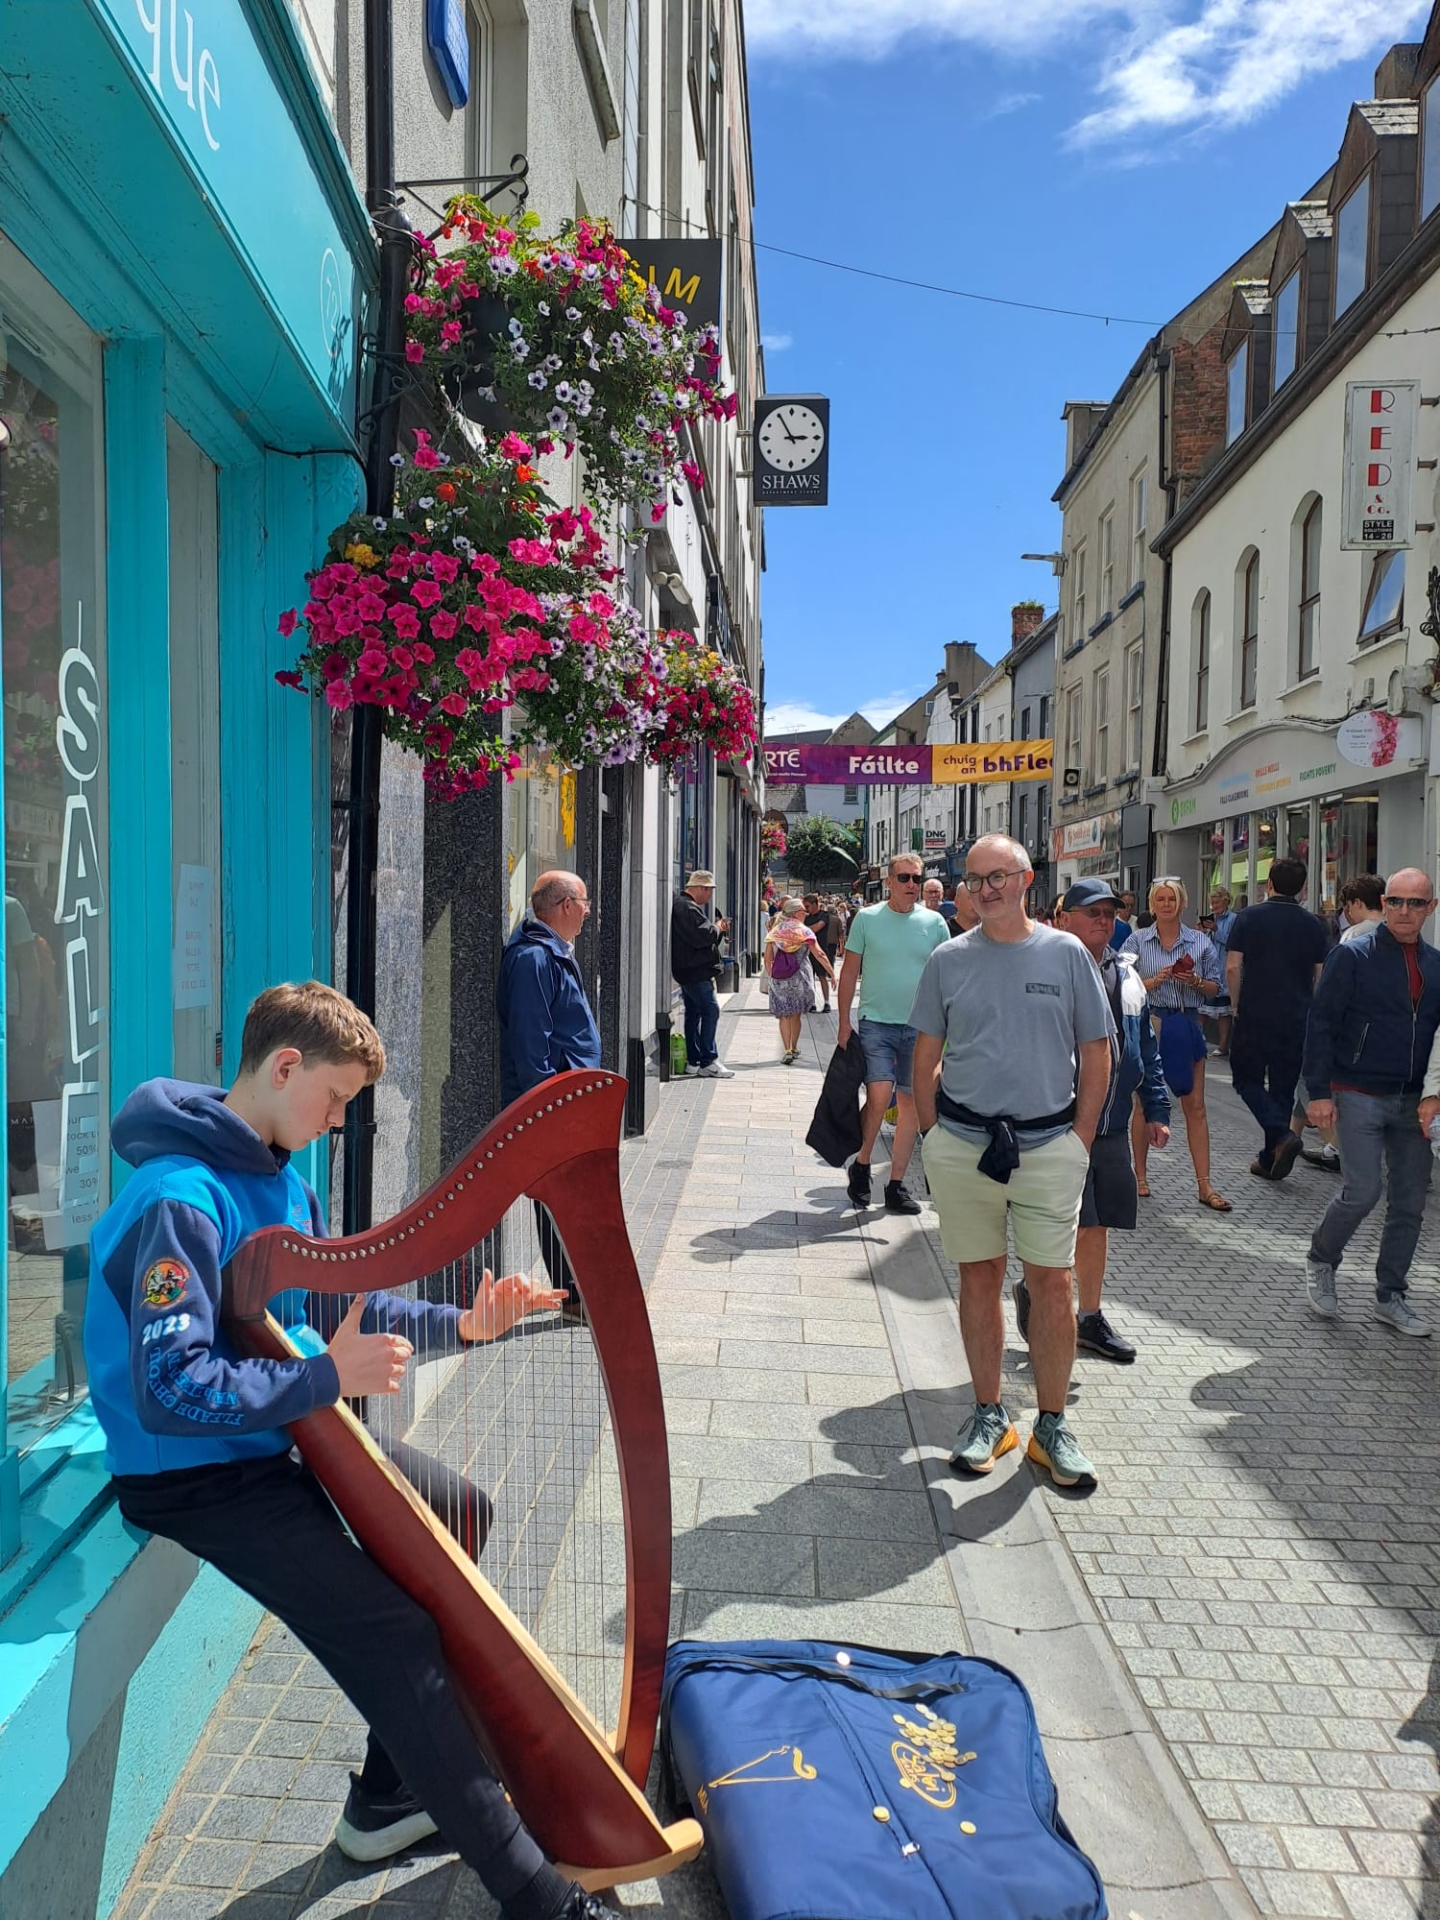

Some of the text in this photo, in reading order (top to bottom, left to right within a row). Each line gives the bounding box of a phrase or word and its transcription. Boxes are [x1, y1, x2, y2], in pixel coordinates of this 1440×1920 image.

[1368, 390, 1395, 487] RED
[762, 474, 820, 489] SHAWS
[1374, 493, 1384, 503] &
[1367, 504, 1390, 514] Co.
[1364, 520, 1393, 528] STYLE
[849, 755, 920, 775] Fáilte
[943, 754, 977, 767] chuig
[961, 765, 977, 775] an
[1315, 763, 1337, 777] POVERTY
[925, 830, 946, 838] DNG
[71, 1213, 93, 1224] less
[142, 1313, 191, 1346] 2023
[174, 1402, 245, 1426] FLEADH
